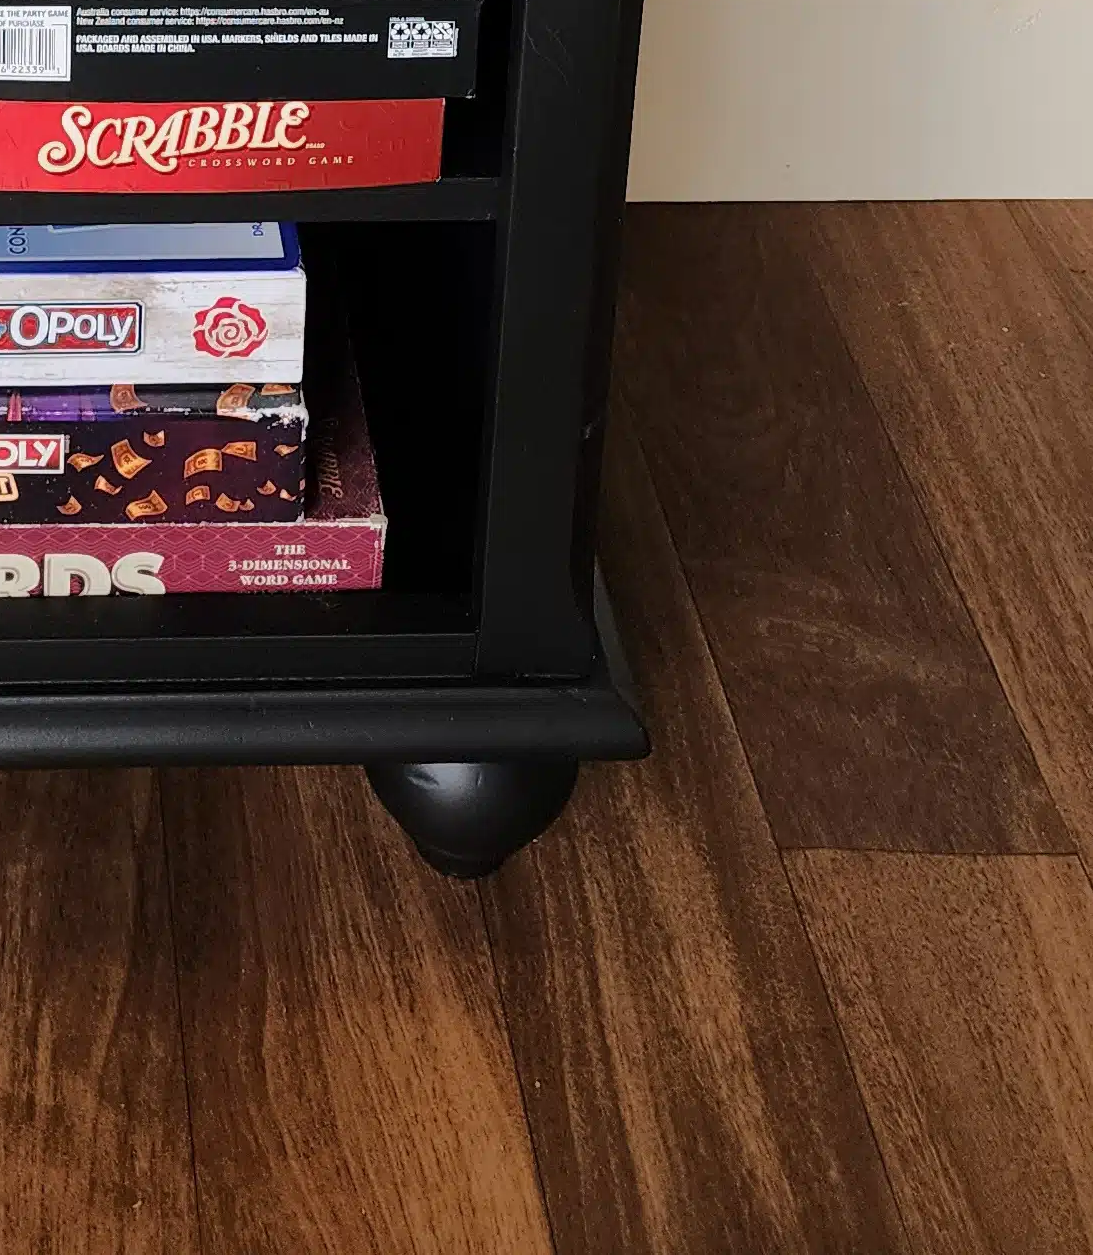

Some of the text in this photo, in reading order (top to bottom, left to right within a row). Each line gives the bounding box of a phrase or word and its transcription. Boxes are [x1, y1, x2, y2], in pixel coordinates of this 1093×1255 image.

[7, 9, 20, 17] THE
[22, 9, 46, 17] PARTY
[48, 9, 69, 17] GAME
[76, 7, 110, 17] Australia
[111, 7, 148, 17] consumer
[76, 17, 94, 26] New
[95, 17, 125, 26] Zealand
[126, 17, 164, 26] consumer
[75, 34, 379, 43] PACKAGED AND ASSEMBLED IN USA. MARKERS, SHIELDS AND TILES MADE IN
[75, 44, 195, 53] USA. BOARDS MADE IN CHINA.
[11, 66, 45, 74] 22339
[37, 101, 311, 173] SCRABBLE
[188, 155, 355, 168] CROSSWORD GAME
[273, 544, 306, 556] THE
[227, 559, 352, 572] 3-DIMENSIONAL
[239, 574, 338, 586] WORD GAME
